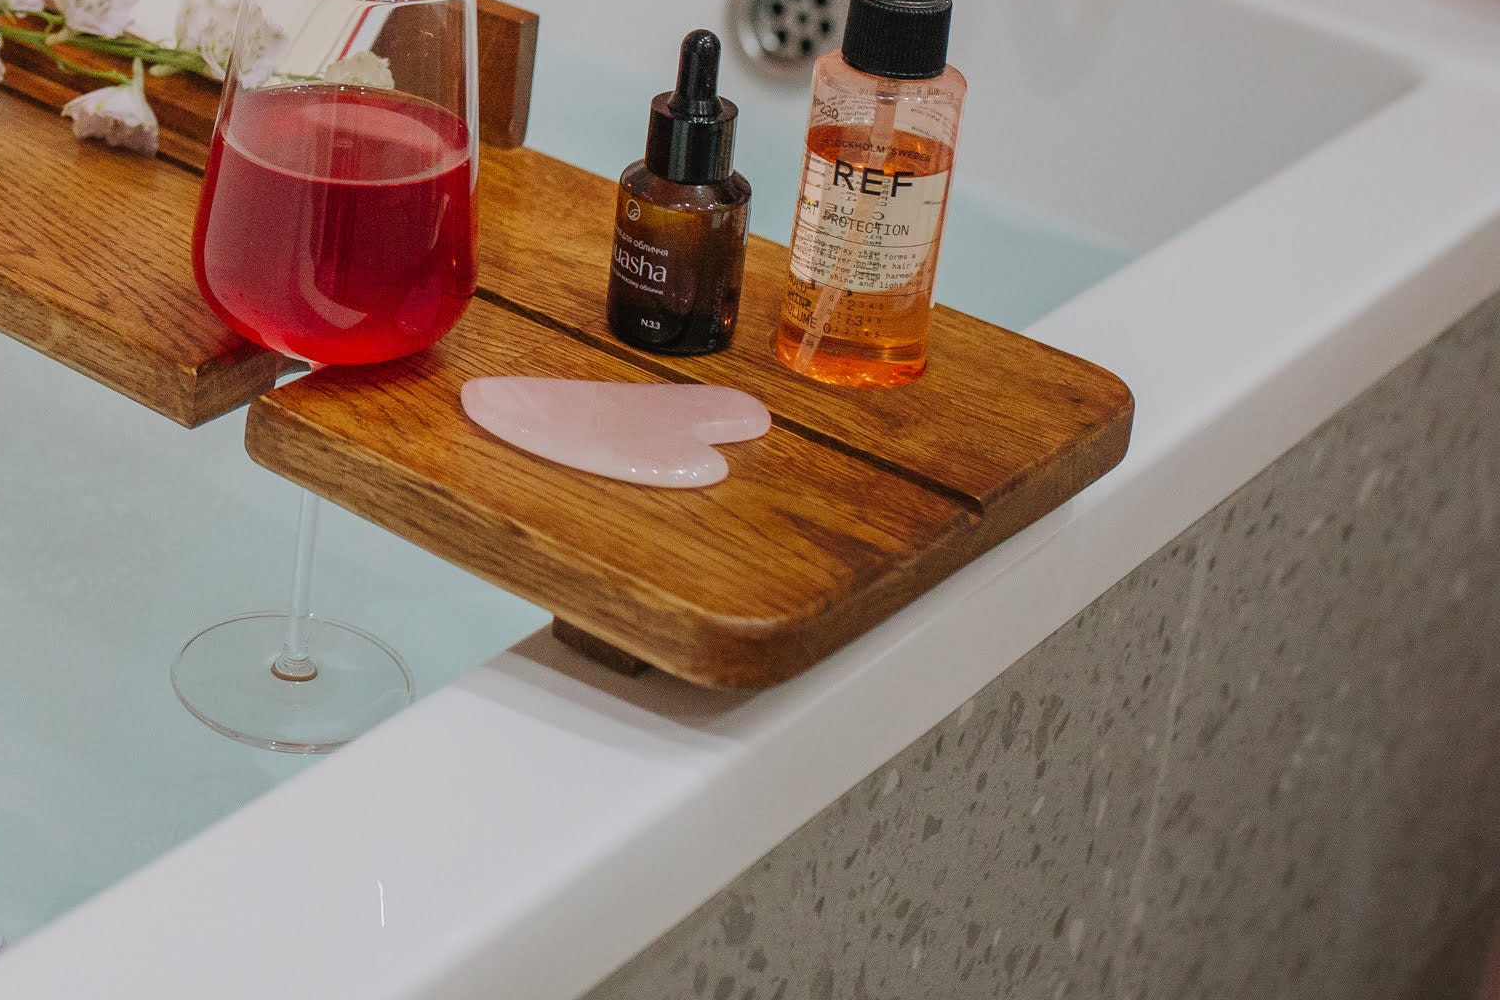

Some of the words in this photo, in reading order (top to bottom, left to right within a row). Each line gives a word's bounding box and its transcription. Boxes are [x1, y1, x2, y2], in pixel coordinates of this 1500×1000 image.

[823, 138, 885, 154] STOCKHOLM
[891, 147, 932, 162] SWEDEN
[833, 159, 915, 198] REF
[822, 209, 911, 236] PROTECTION
[633, 239, 669, 257] обличчя
[613, 243, 667, 283] uasha
